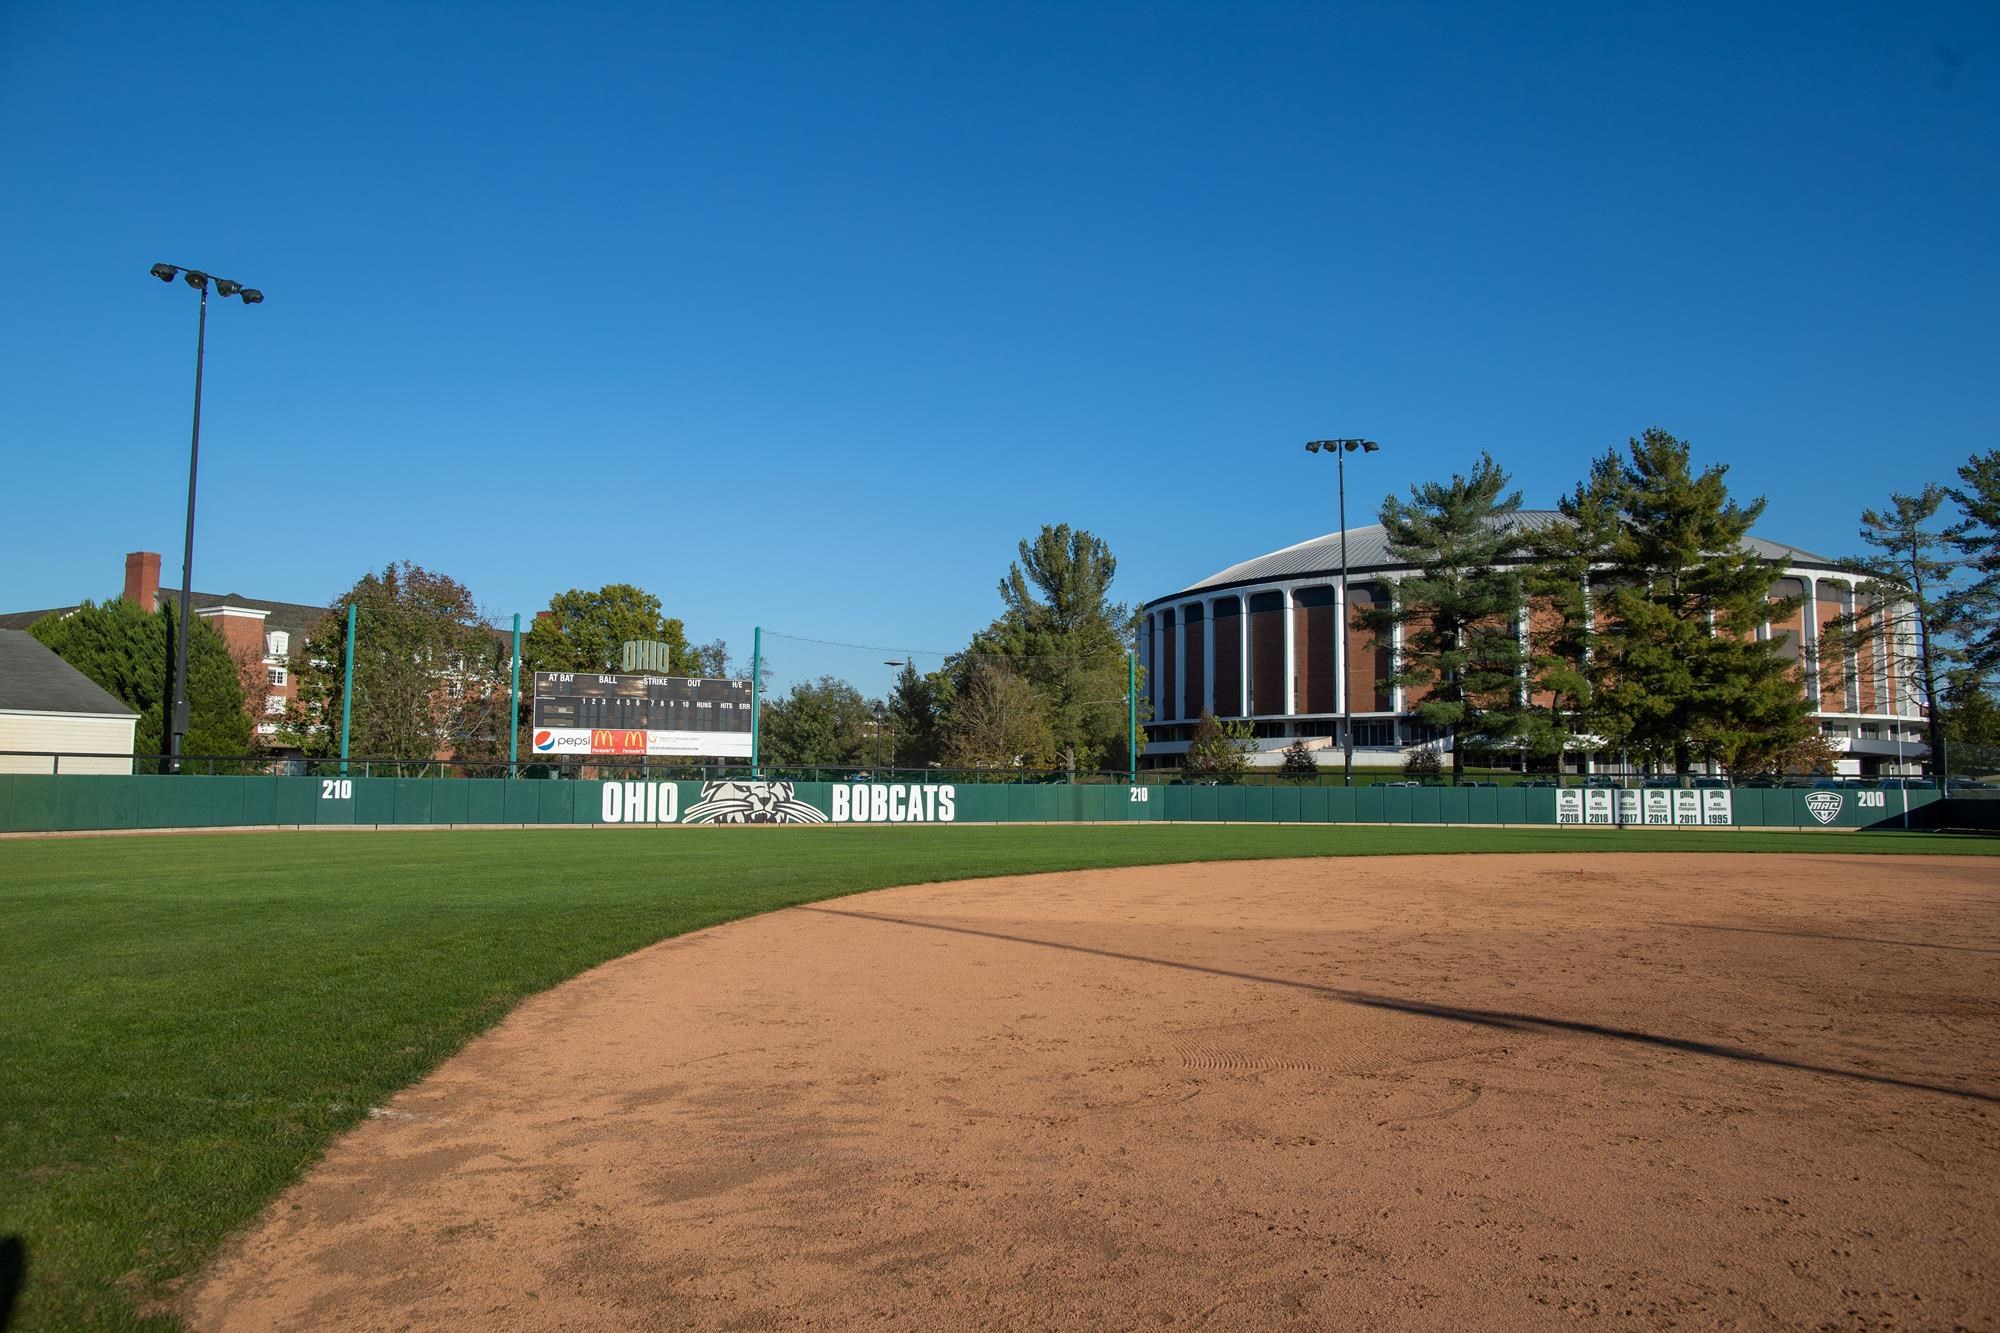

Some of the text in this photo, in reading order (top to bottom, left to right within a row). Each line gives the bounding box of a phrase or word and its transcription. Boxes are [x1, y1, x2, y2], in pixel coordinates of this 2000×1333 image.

[623, 640, 670, 673] OHIO
[549, 674, 574, 682] AT BAT
[599, 676, 617, 684] BALL
[643, 678, 668, 686] STRIKE
[687, 679, 701, 688] OUT
[557, 736, 590, 747] pepsi
[322, 780, 352, 799] 210
[1562, 790, 1576, 798] OHIO
[1591, 790, 1605, 798] OHIO
[1620, 790, 1634, 798] OHIO
[1130, 787, 1148, 802] 210
[1710, 791, 1724, 799] OHIO
[1857, 791, 1885, 807] 200
[602, 782, 955, 823] OHIO BOBCATS
[1810, 802, 1839, 810] MAC
[1560, 814, 1579, 823] 2018
[1589, 814, 1608, 823] 2018
[1620, 814, 1638, 823] 2017
[1648, 814, 1668, 824] 2014
[1679, 814, 1697, 824] 2011
[1708, 814, 1728, 824] 1995
